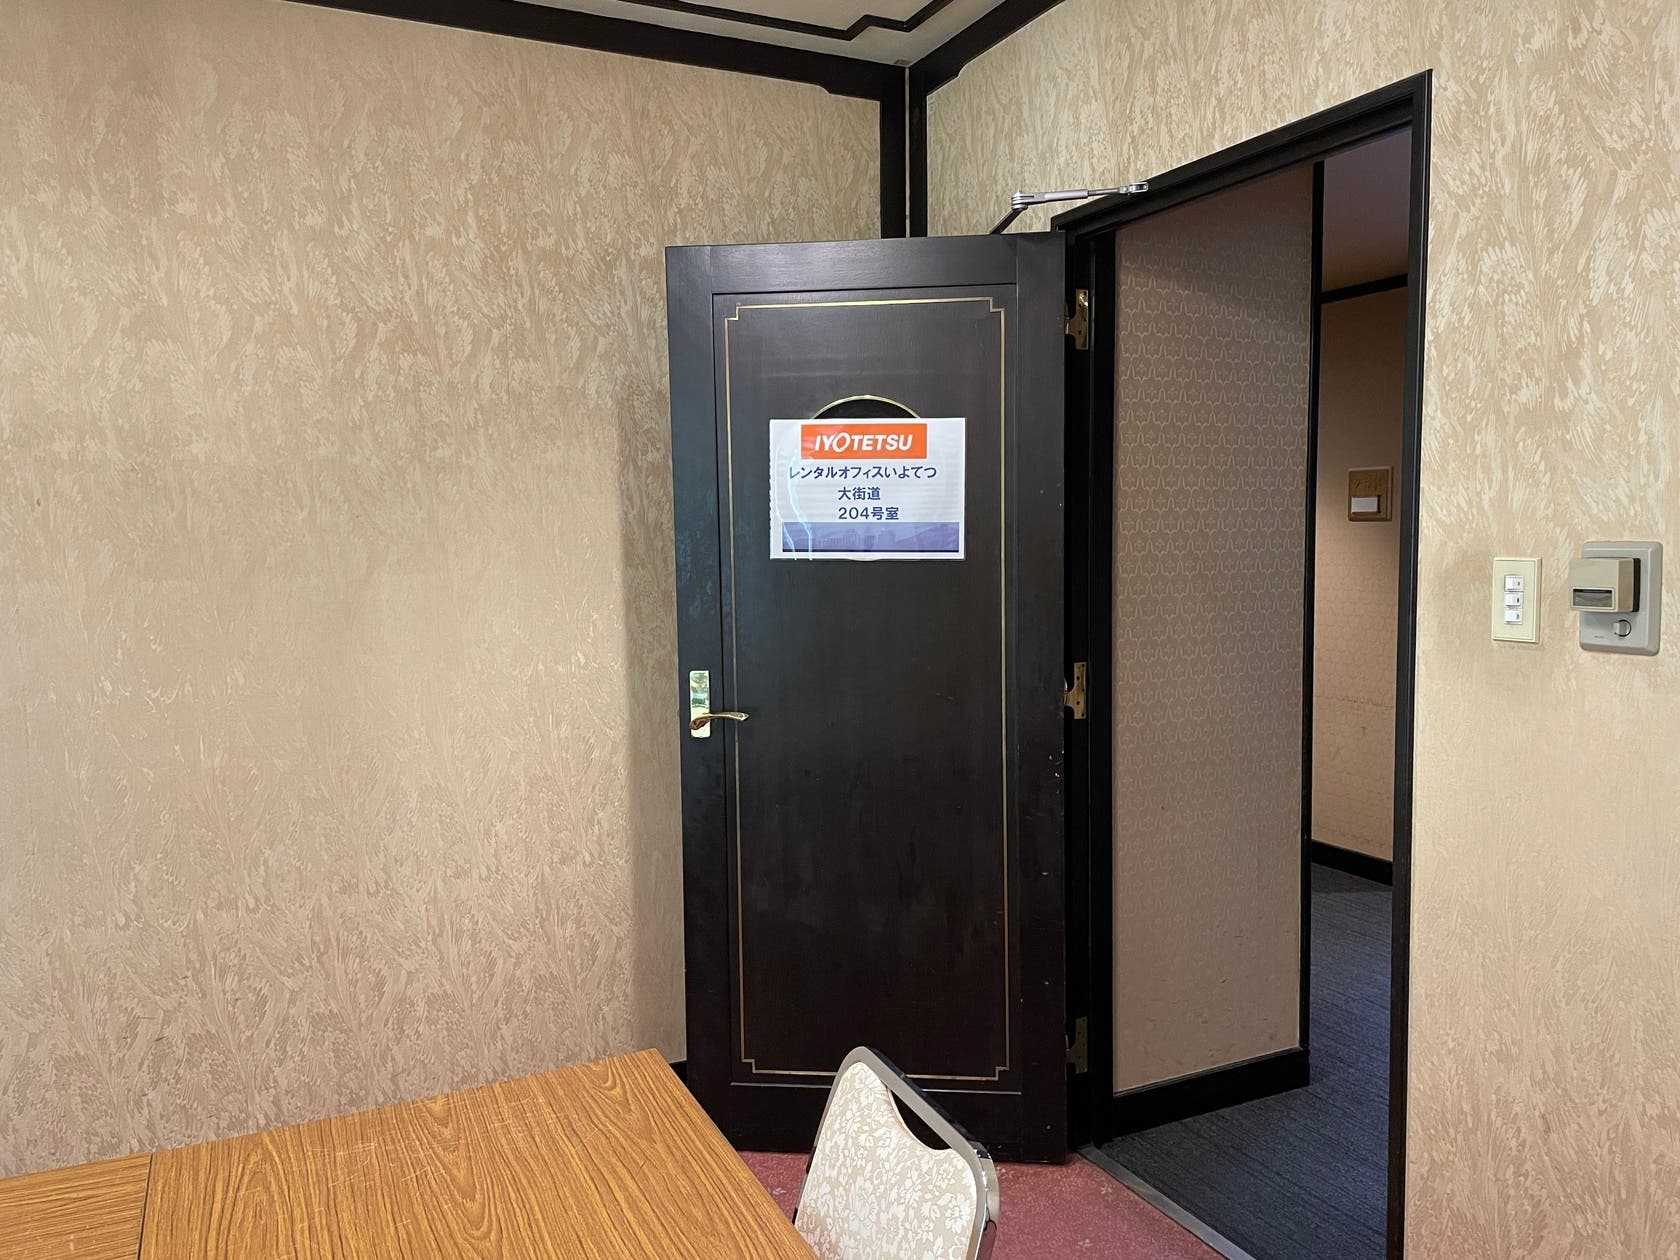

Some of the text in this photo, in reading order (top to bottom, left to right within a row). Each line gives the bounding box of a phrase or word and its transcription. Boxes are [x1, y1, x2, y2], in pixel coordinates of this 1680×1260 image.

[814, 432, 912, 453] IYOTETSU
[789, 466, 937, 480] レンタルオフィスいよてつ
[837, 486, 881, 501] 大街道
[838, 506, 900, 520] 204号室
